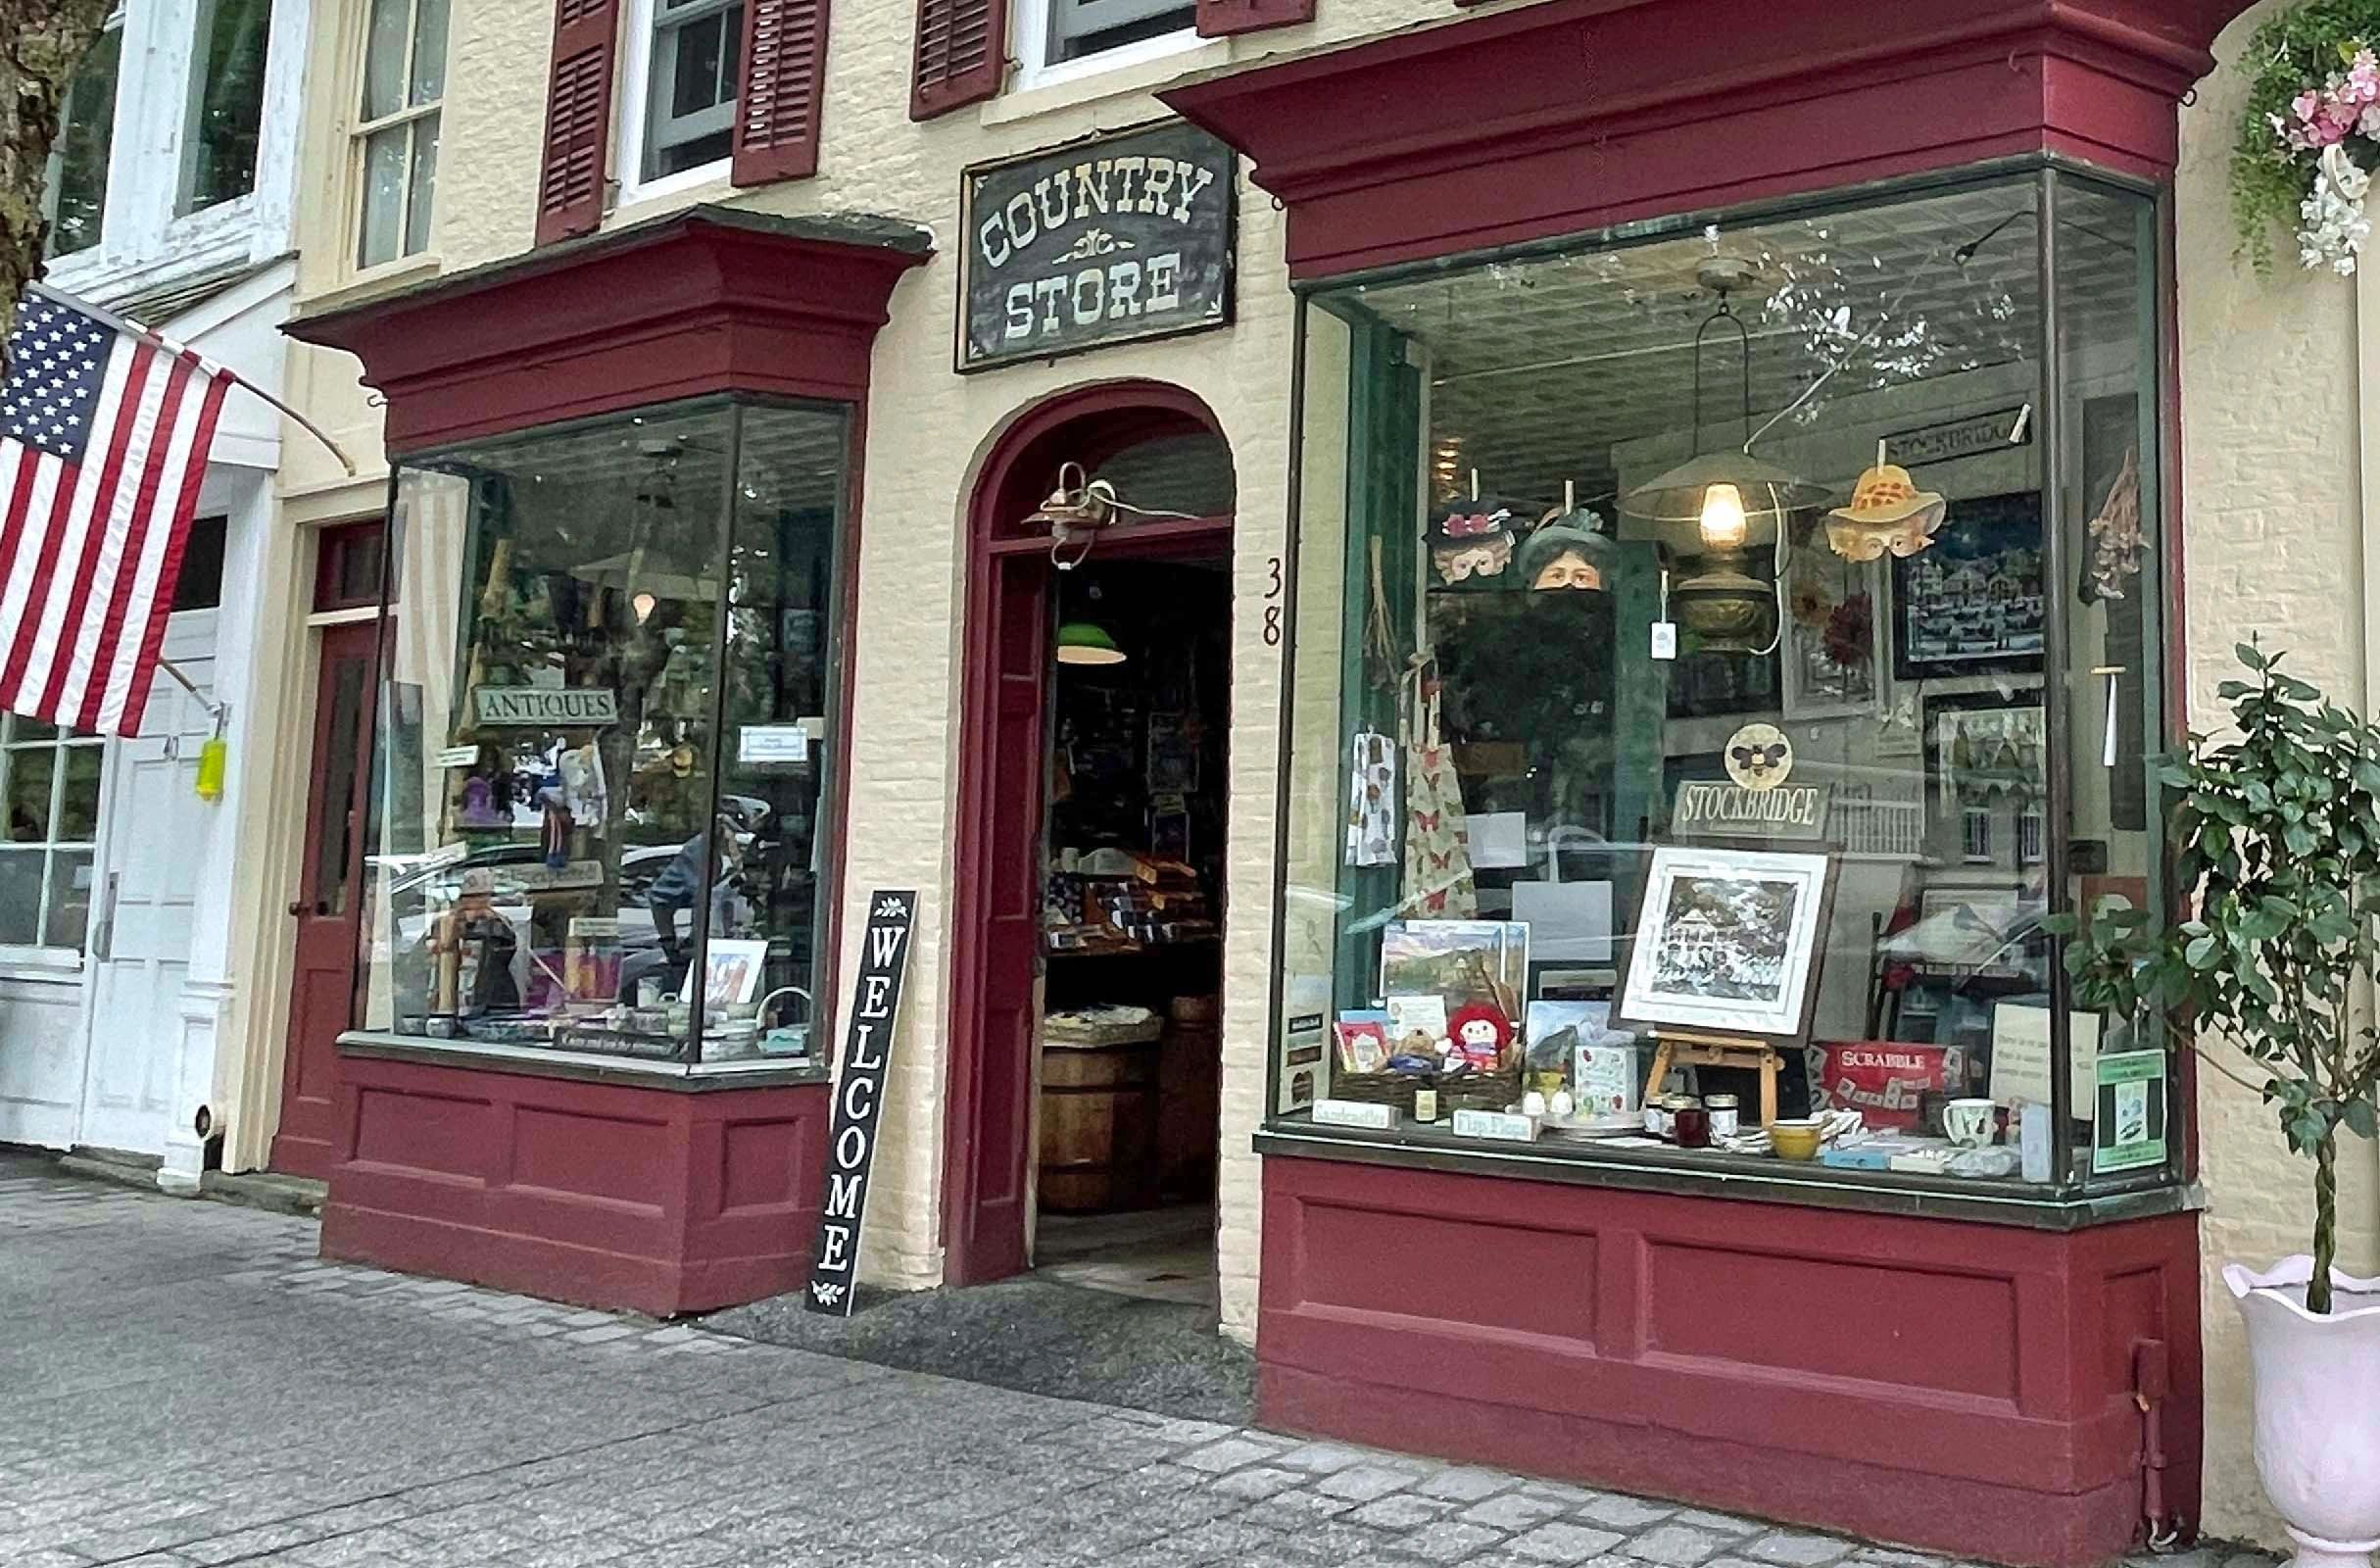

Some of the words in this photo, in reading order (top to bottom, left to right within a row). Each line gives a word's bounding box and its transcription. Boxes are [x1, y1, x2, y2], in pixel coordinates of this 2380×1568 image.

[980, 157, 1214, 269] COUNTRY
[1004, 253, 1181, 339] STORE
[1263, 557, 1281, 646] 38
[485, 693, 611, 717] ANTIQUES
[1681, 785, 1819, 825] STOCKBRIDGE
[817, 925, 905, 1273] WELCOME
[1841, 1051, 1925, 1070] SCRABBLE
